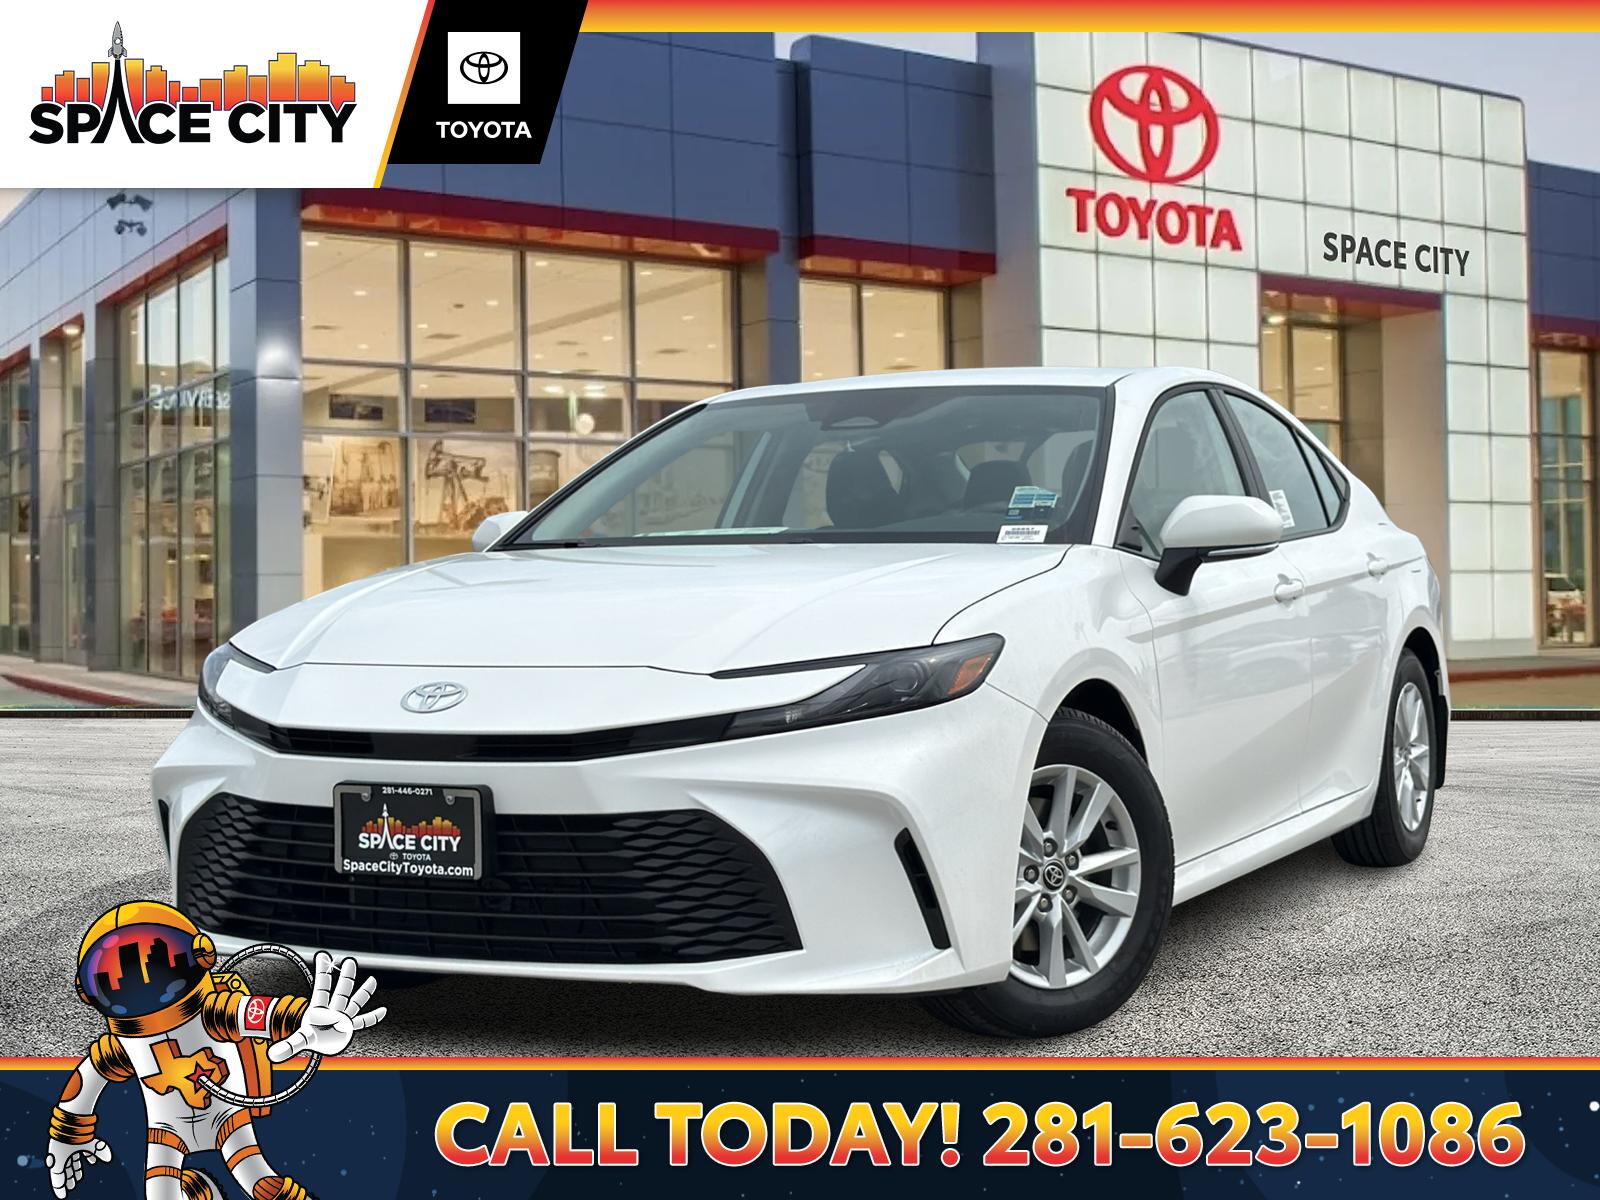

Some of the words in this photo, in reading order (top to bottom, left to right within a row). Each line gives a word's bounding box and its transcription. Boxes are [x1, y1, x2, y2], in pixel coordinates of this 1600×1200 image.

[1065, 187, 1243, 251] TOYOTA
[1322, 231, 1407, 271] SPACE
[1414, 244, 1471, 277] CITY
[382, 786, 433, 796] 281-446-0271
[358, 826, 416, 851] SPACE
[420, 834, 461, 852] CITY
[343, 858, 473, 877] SpaceCityToyota.com
[402, 852, 432, 861] TOYOTA
